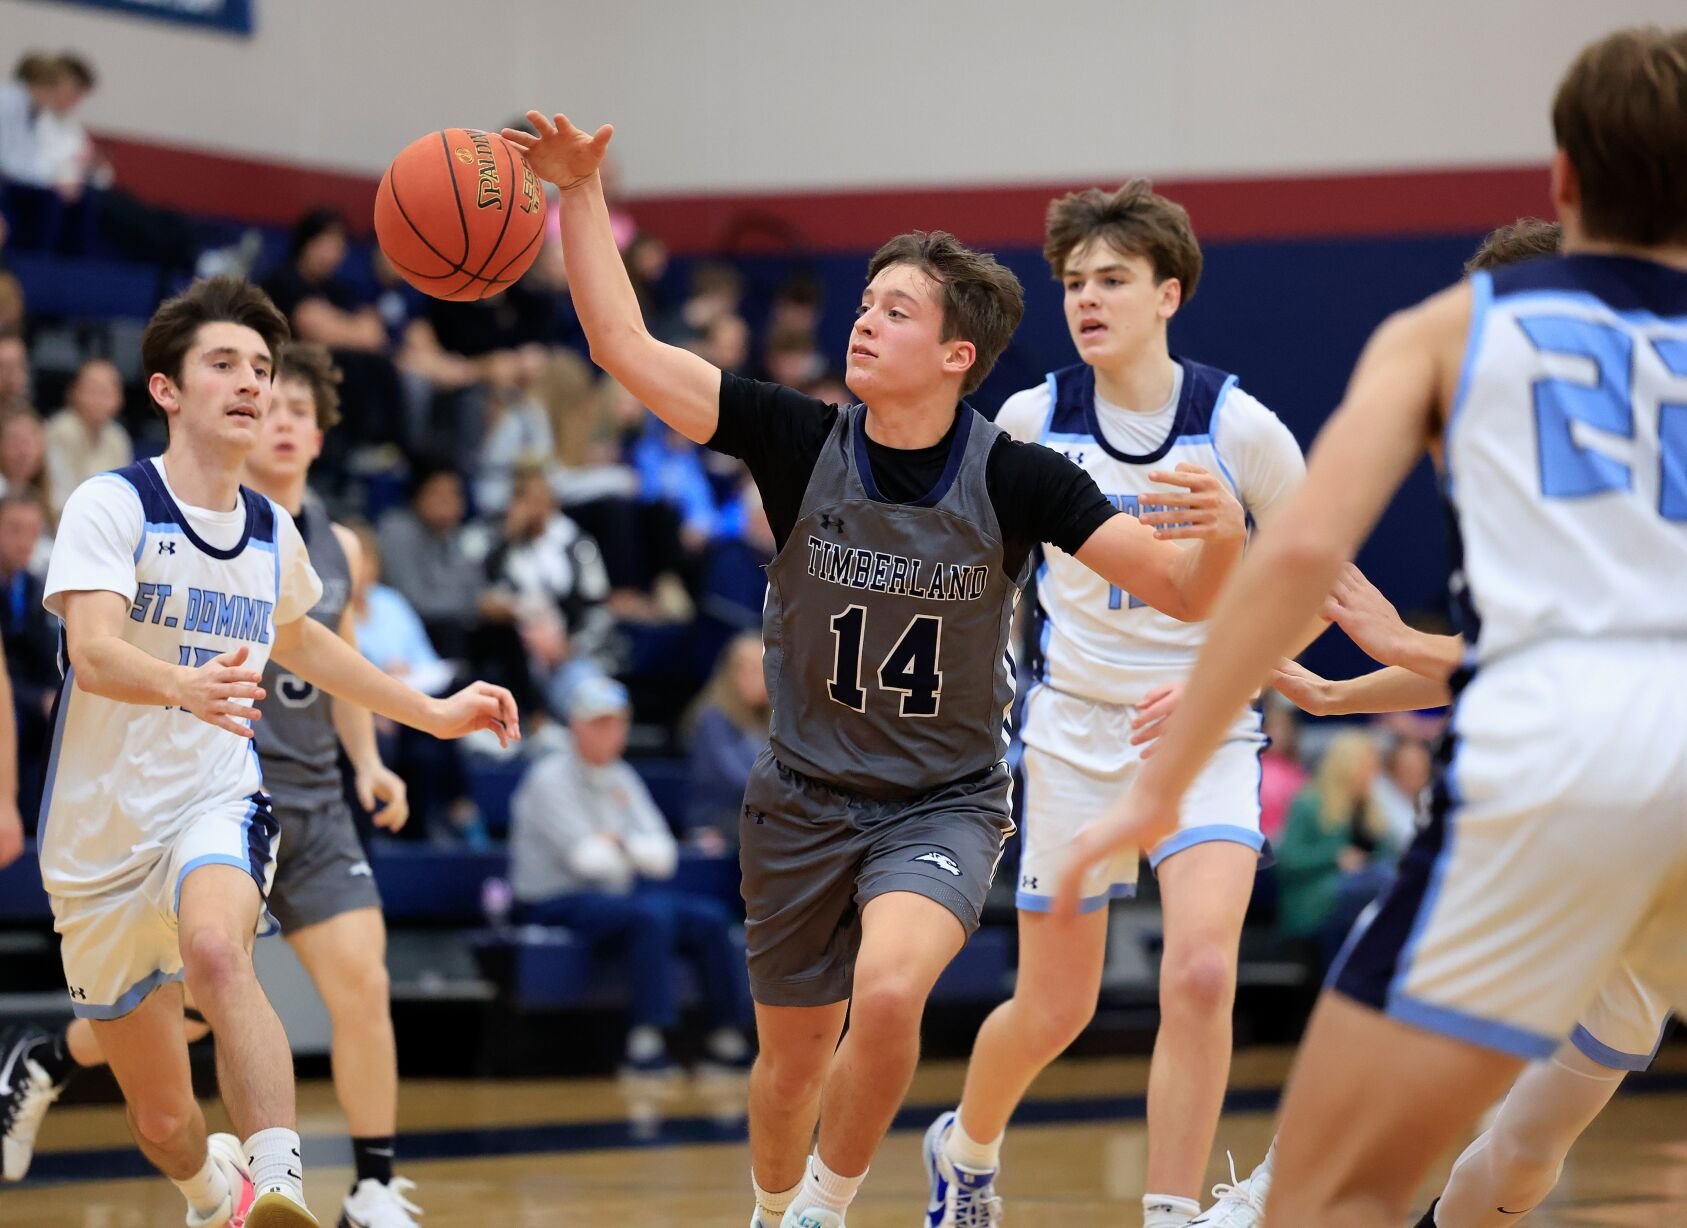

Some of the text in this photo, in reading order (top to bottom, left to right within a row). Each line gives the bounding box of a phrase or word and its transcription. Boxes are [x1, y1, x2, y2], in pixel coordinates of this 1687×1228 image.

[808, 535, 989, 600] TIMBERLAND
[130, 582, 178, 628] ST.
[183, 587, 273, 645] DOMINIC
[827, 604, 943, 717] 14
